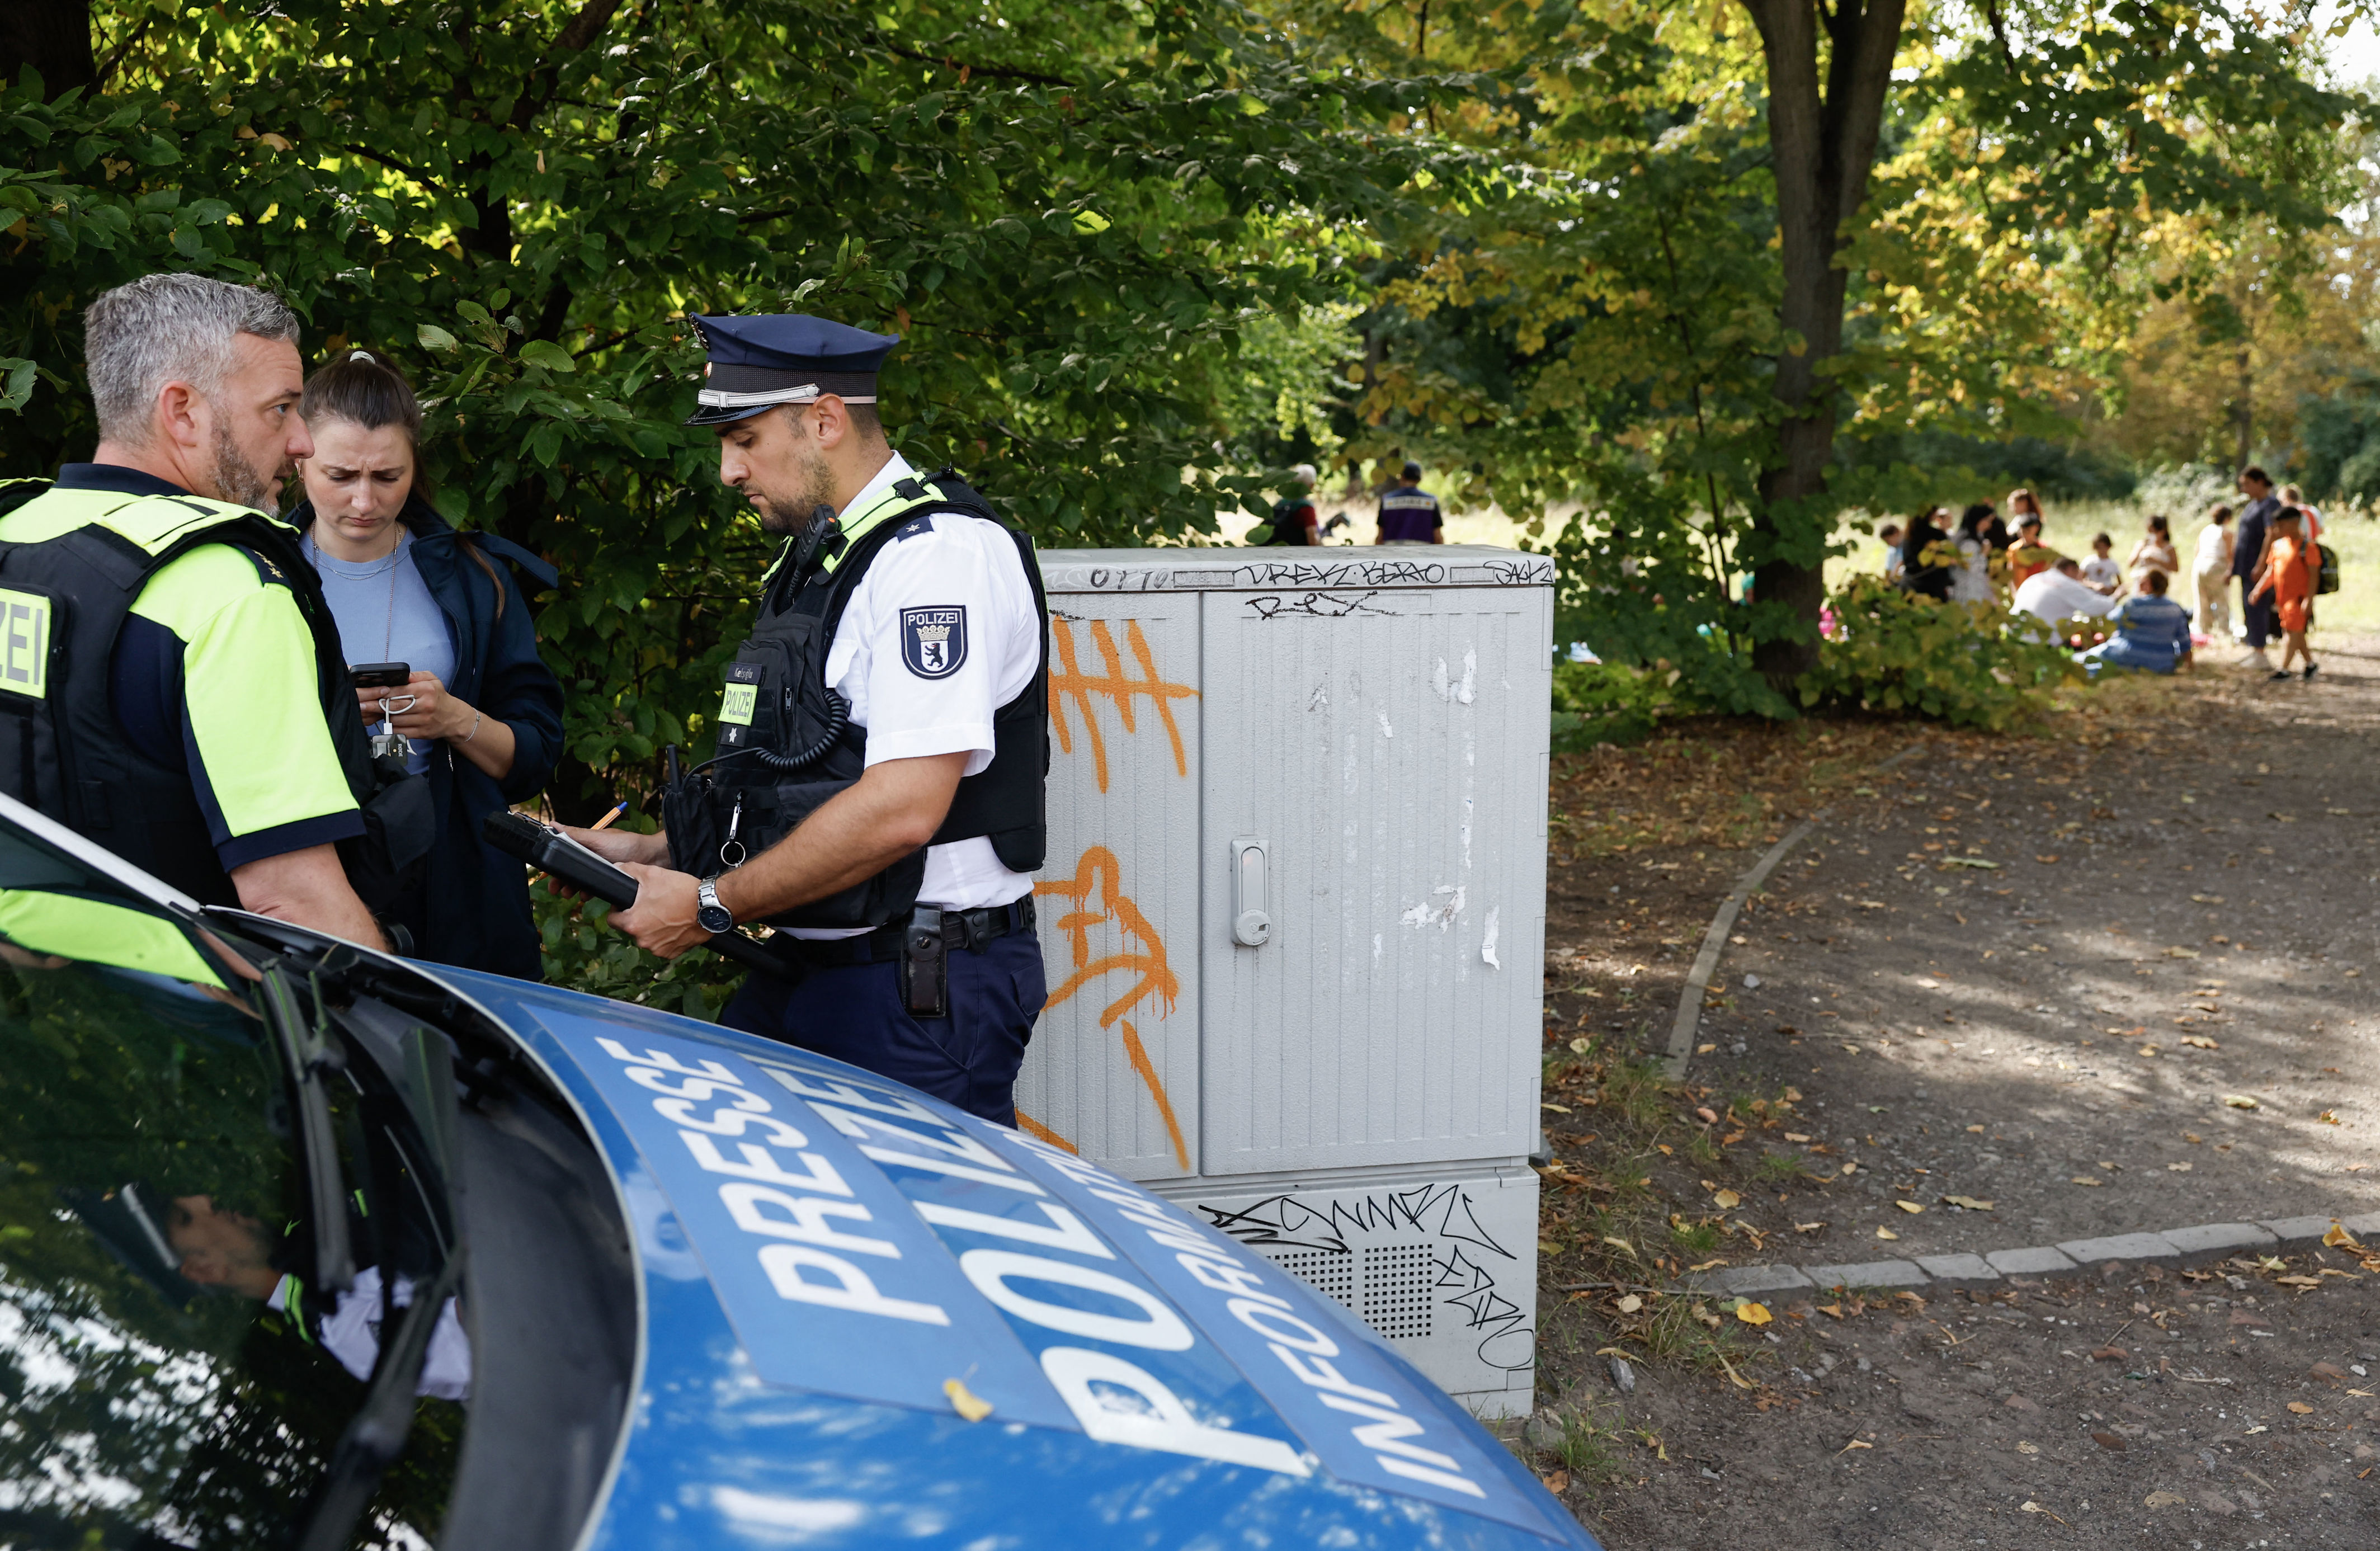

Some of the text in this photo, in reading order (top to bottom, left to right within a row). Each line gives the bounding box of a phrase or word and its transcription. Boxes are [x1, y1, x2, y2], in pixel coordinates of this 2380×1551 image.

[907, 612, 958, 626] POLIZEI
[723, 690, 753, 717] POLIZEI
[595, 1036, 950, 1326] PRESSE
[737, 1052, 1313, 1478] POLIZEI
